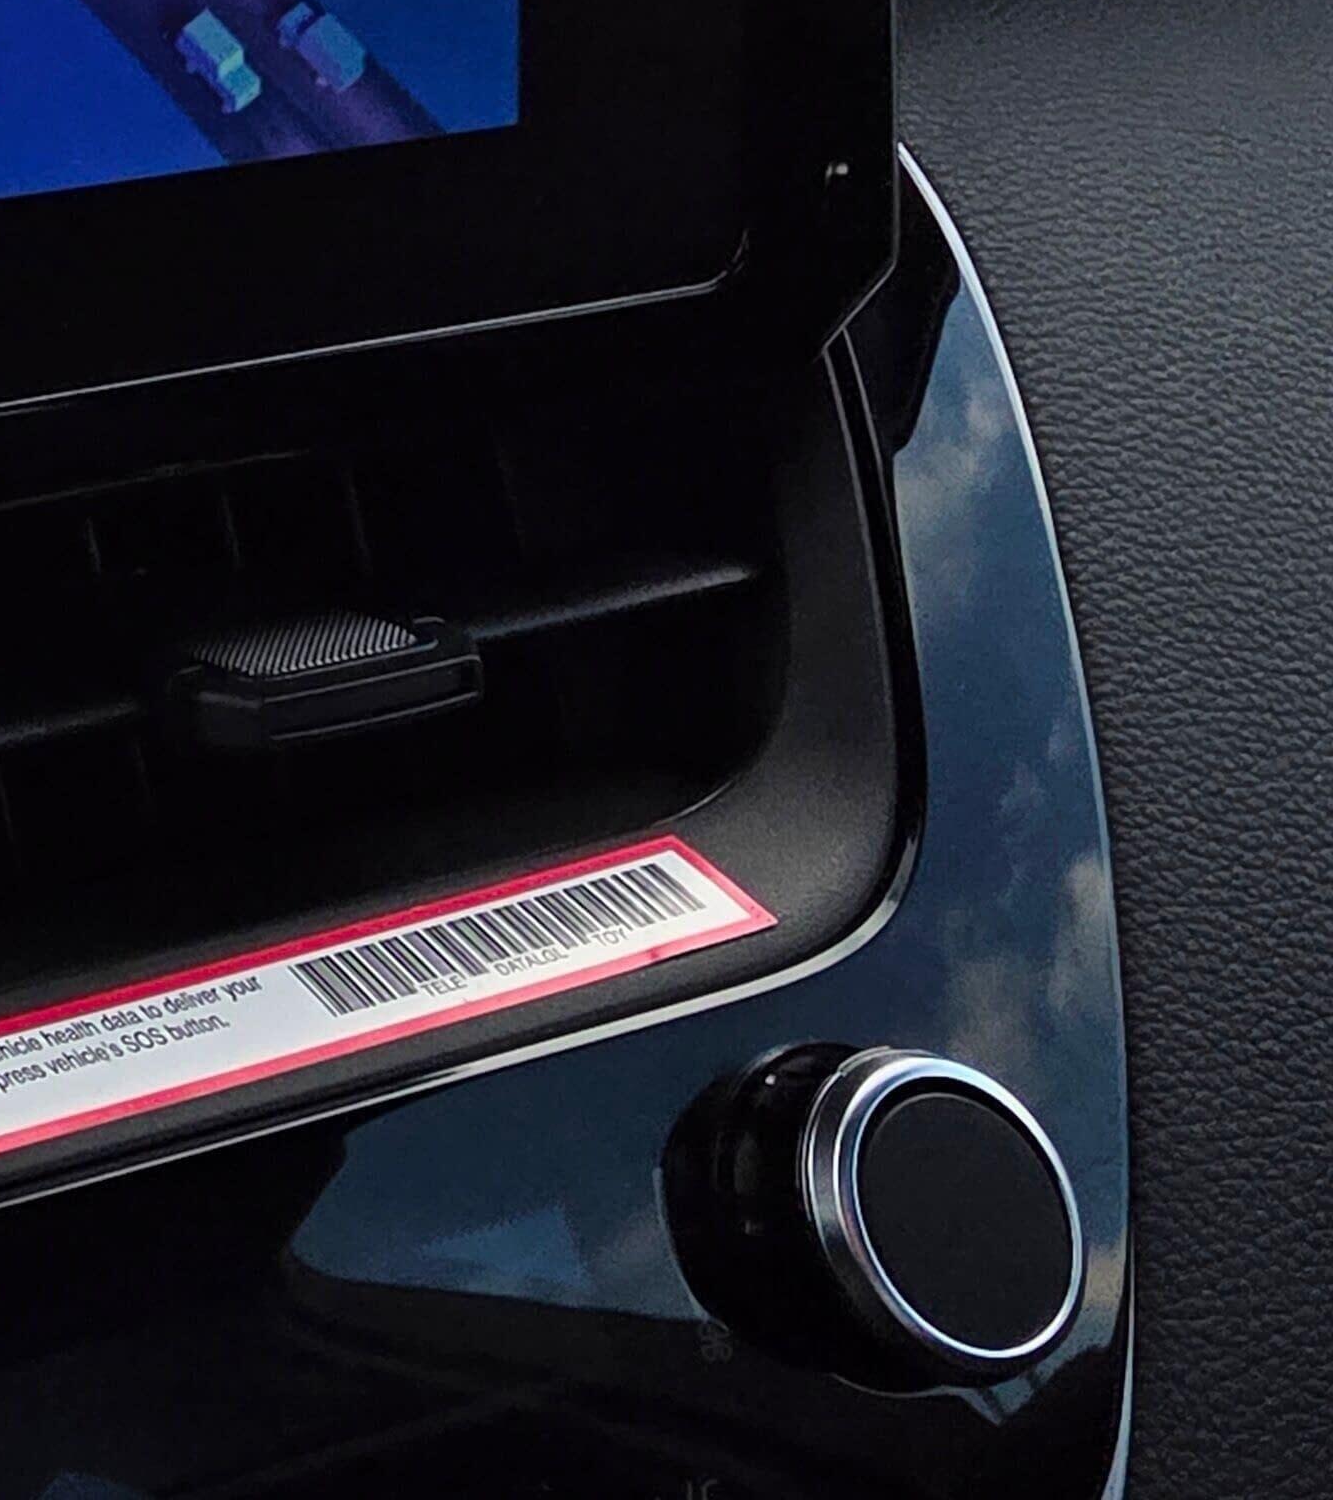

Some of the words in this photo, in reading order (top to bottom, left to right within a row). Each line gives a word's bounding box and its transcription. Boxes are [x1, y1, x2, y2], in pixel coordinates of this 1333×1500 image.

[420, 974, 467, 998] TELE
[592, 928, 628, 947] TOY
[39, 1020, 100, 1048] health
[100, 1012, 143, 1032] data
[139, 1004, 163, 1020] to
[163, 988, 221, 1015] deliver
[221, 976, 263, 1002] your
[44, 1041, 124, 1075] vehicle's
[120, 1027, 168, 1053] SOS
[163, 1013, 230, 1040] button.
